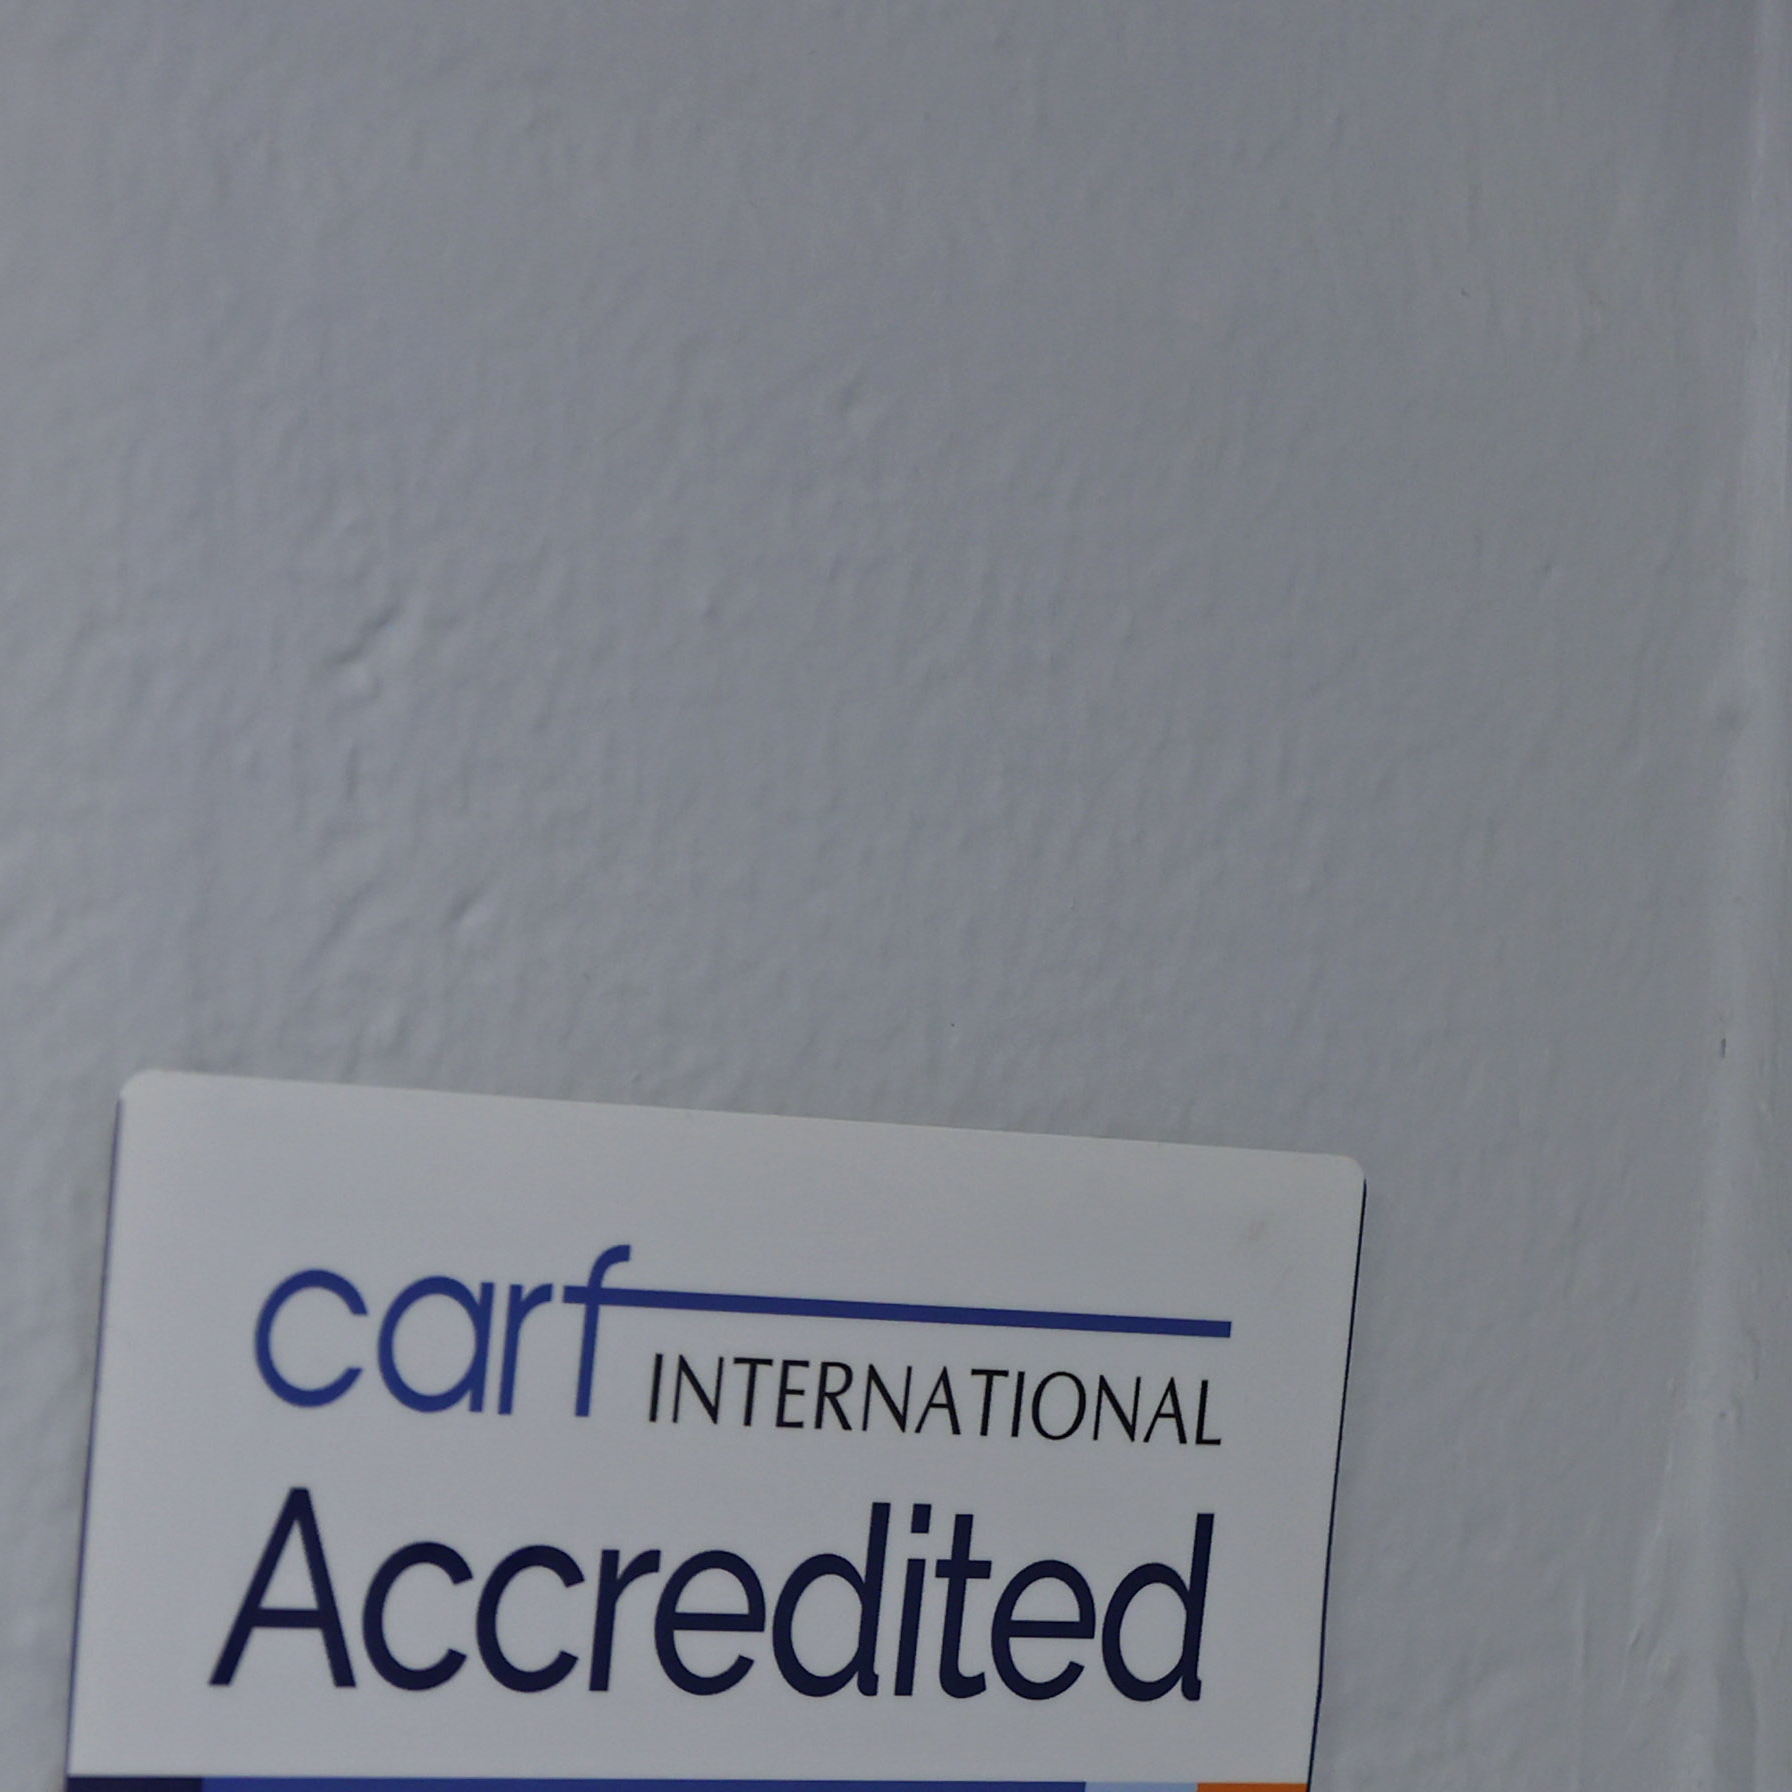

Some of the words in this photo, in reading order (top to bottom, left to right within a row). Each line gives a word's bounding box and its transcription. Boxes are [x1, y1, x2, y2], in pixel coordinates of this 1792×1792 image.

[254, 1245, 631, 1417] carf
[647, 1352, 1223, 1447] INTERNATIONAL
[208, 1486, 1217, 1703] Accredited
